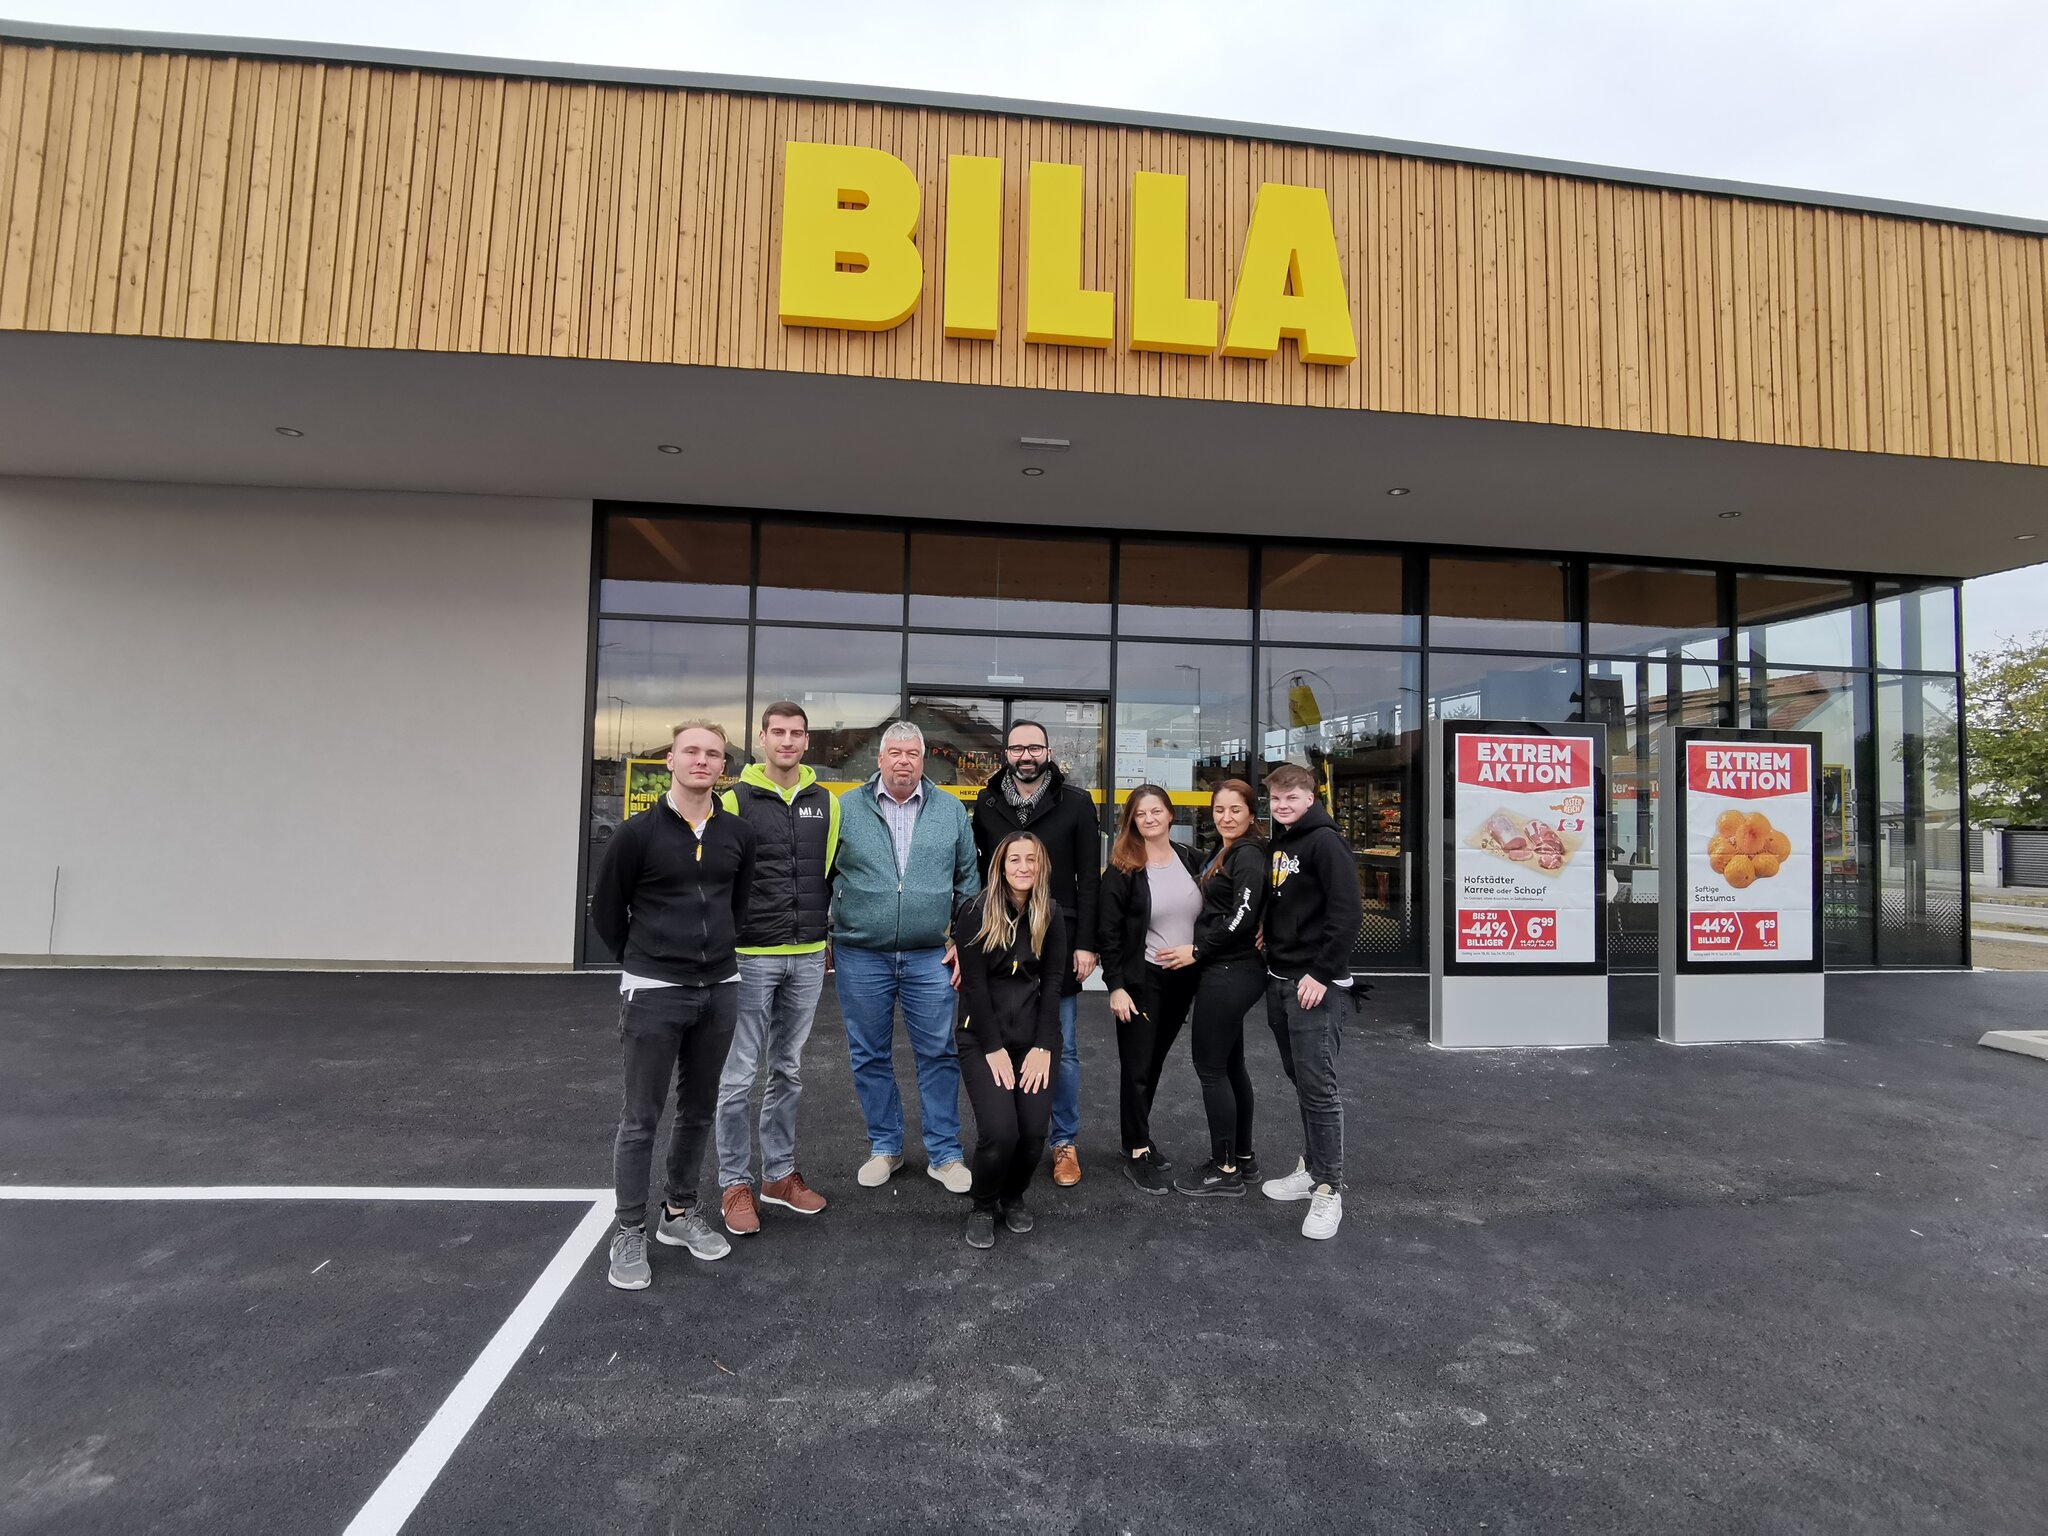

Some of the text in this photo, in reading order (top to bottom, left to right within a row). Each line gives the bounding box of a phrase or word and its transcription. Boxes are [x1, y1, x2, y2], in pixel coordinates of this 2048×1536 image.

[779, 141, 1358, 367] BILLA
[1477, 742, 1572, 764] EXTREM
[1705, 751, 1791, 771] EXTREM
[1477, 763, 1572, 784] AKTION
[1706, 771, 1791, 790] AKTION
[630, 793, 658, 803] MEIN
[1464, 876, 1515, 885] Hofstädter
[1464, 886, 1495, 894] Karree
[1514, 886, 1547, 896] Schopf
[1694, 886, 1719, 894] Saftige
[1694, 894, 1736, 902] Satsumas
[1472, 912, 1486, 920] BIS
[1461, 921, 1509, 938] -44%
[1693, 917, 1736, 933] -44%
[1466, 939, 1504, 947] BILLIGER
[1697, 936, 1731, 945] BILLIGER
